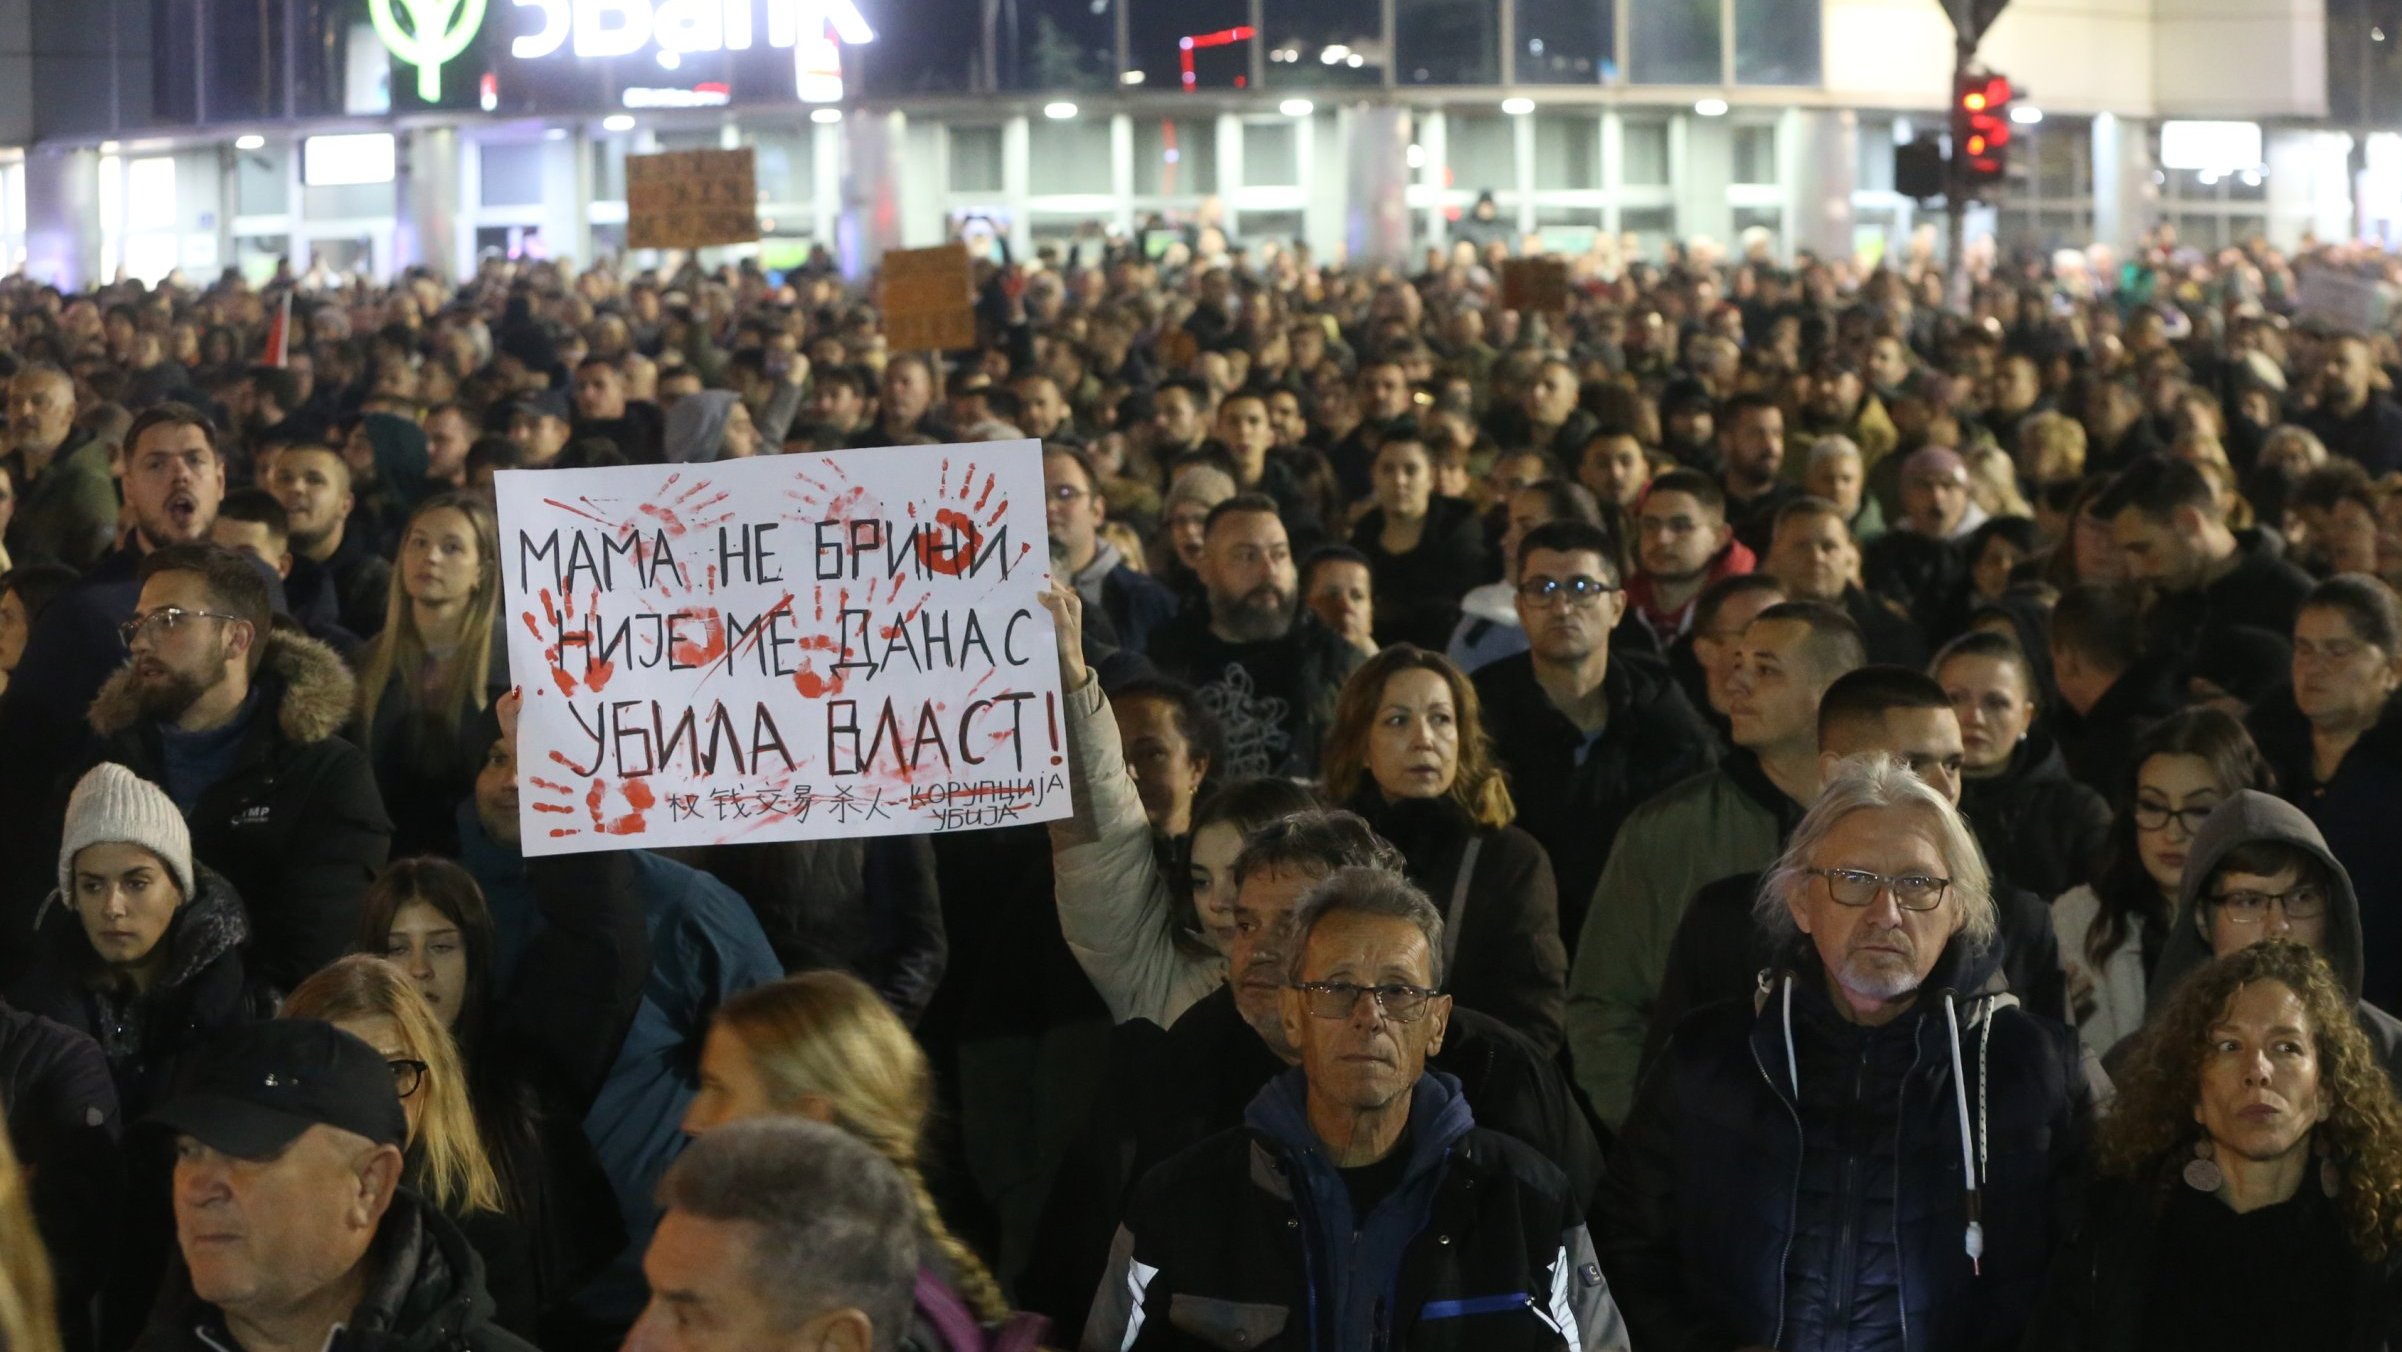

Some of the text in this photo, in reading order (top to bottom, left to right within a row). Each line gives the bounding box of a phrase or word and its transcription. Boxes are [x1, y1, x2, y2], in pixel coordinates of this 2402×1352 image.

[519, 518, 1008, 597] МАМА НЕ БРИНИ
[556, 607, 1032, 682] НИЈЕ МЕ ДАНАС
[568, 690, 1063, 779] УБИЛА ВЛАСТ!
[931, 803, 1019, 831] УБИЈА
